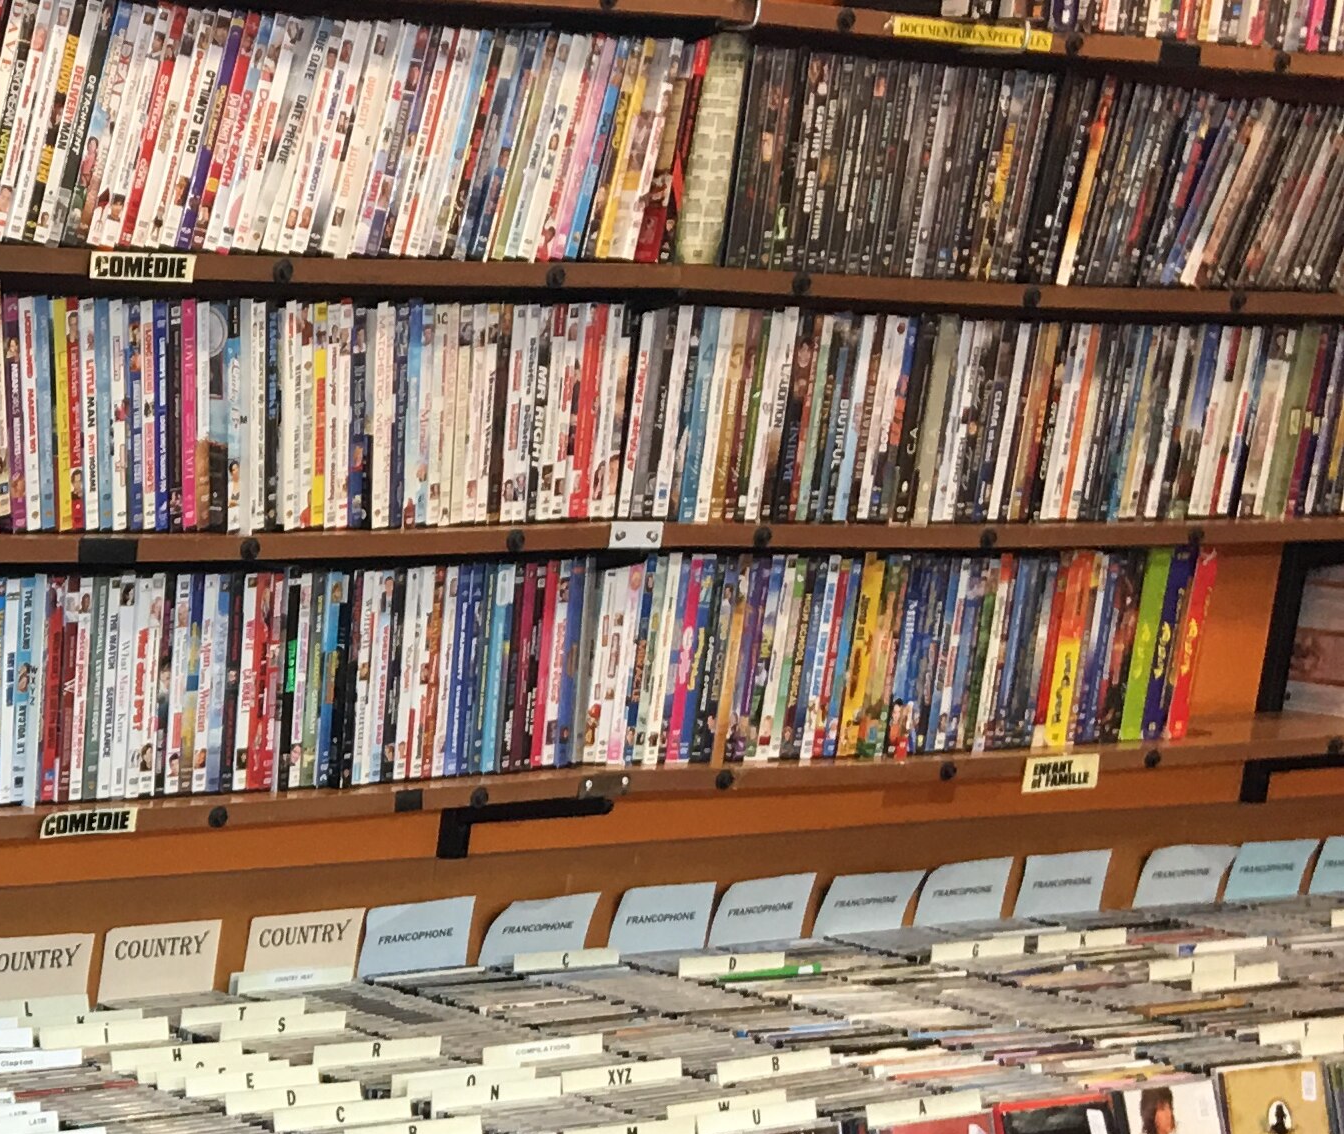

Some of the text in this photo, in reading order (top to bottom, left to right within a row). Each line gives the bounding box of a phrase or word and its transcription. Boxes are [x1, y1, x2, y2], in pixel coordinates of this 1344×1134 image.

[95, 255, 186, 278] COMÉDIE
[1034, 760, 1073, 775] ENFANT
[44, 812, 129, 835] COMÉDIE
[626, 911, 696, 925] FRANCOPHONE
[727, 902, 794, 918] FRANCOPHONE
[259, 919, 352, 948] COUNTRY
[378, 927, 453, 945] FRANCOPHONE
[502, 920, 573, 935] FRANCOPHONE
[114, 931, 210, 959] COUNTRY
[608, 1068, 632, 1085] XYZ
